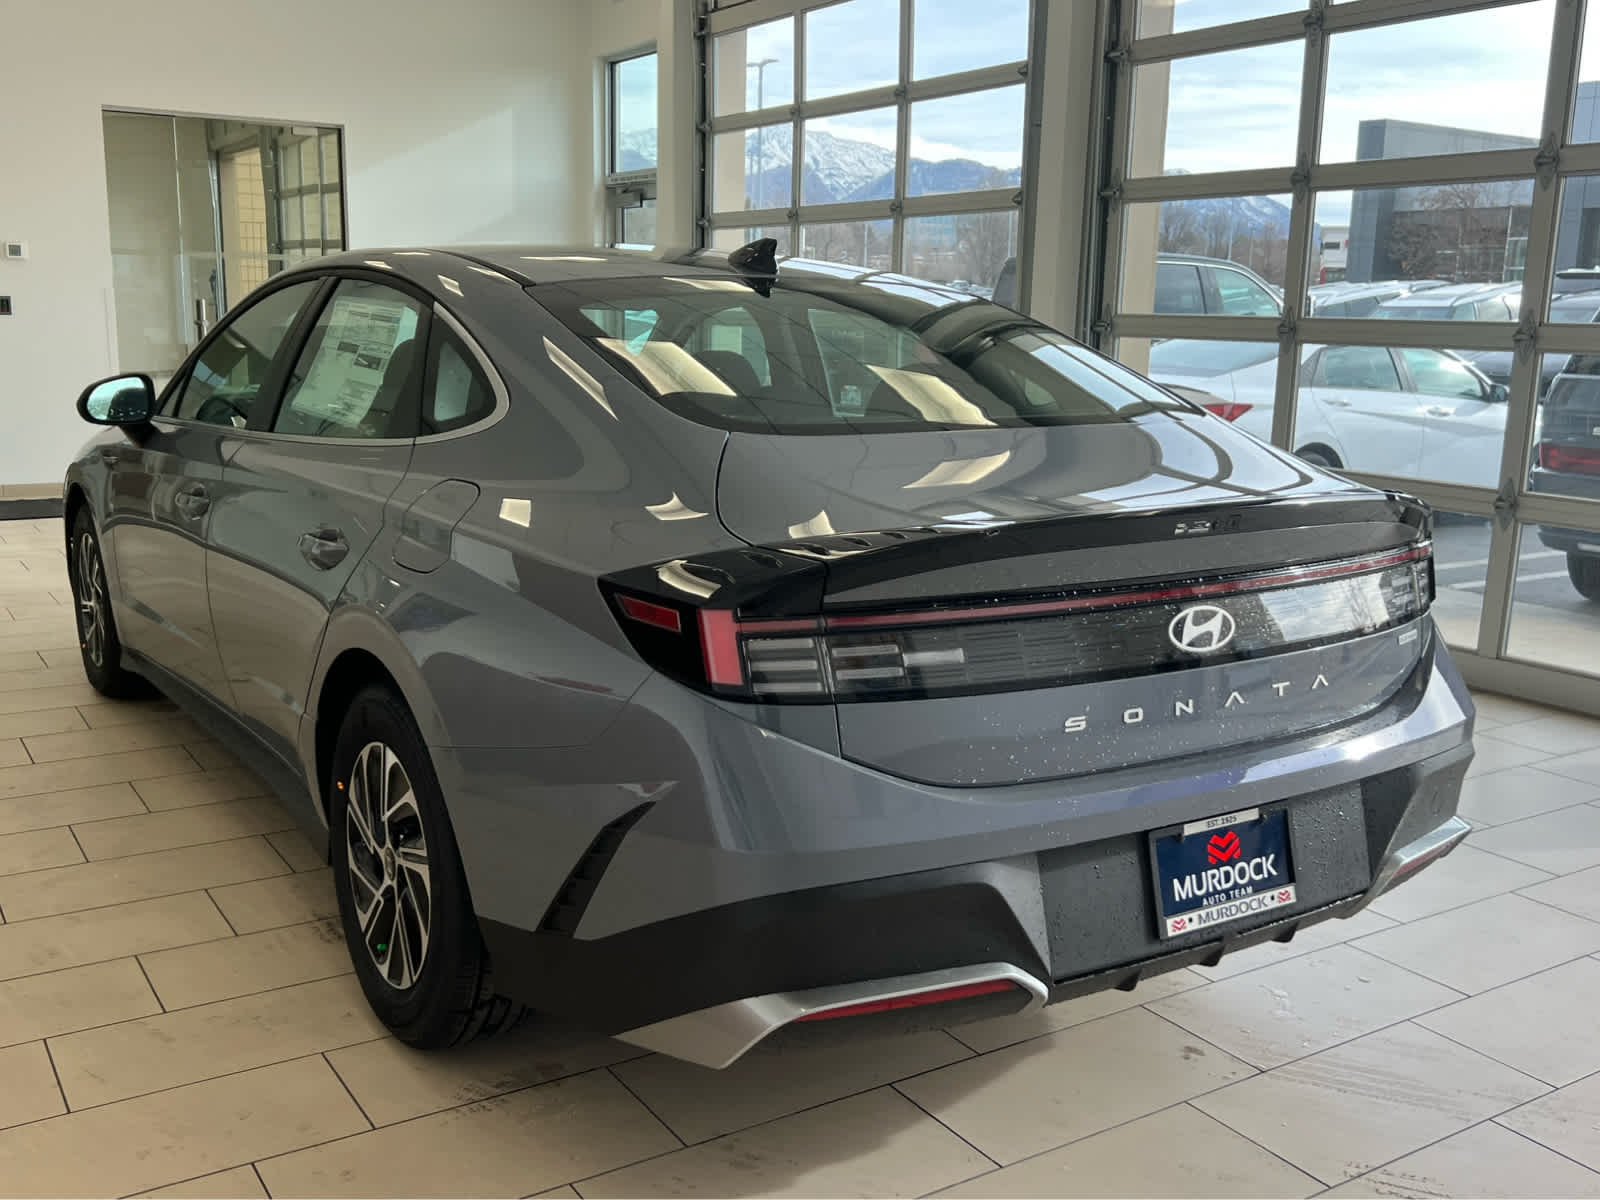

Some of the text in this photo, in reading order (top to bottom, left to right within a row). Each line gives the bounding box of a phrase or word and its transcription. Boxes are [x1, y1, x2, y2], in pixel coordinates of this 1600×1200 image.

[1064, 673, 1329, 733] SONATA
[1173, 853, 1278, 902] MURDOCK
[1202, 886, 1253, 907] AUTO TEAM
[1198, 896, 1268, 925] MURDOCK
